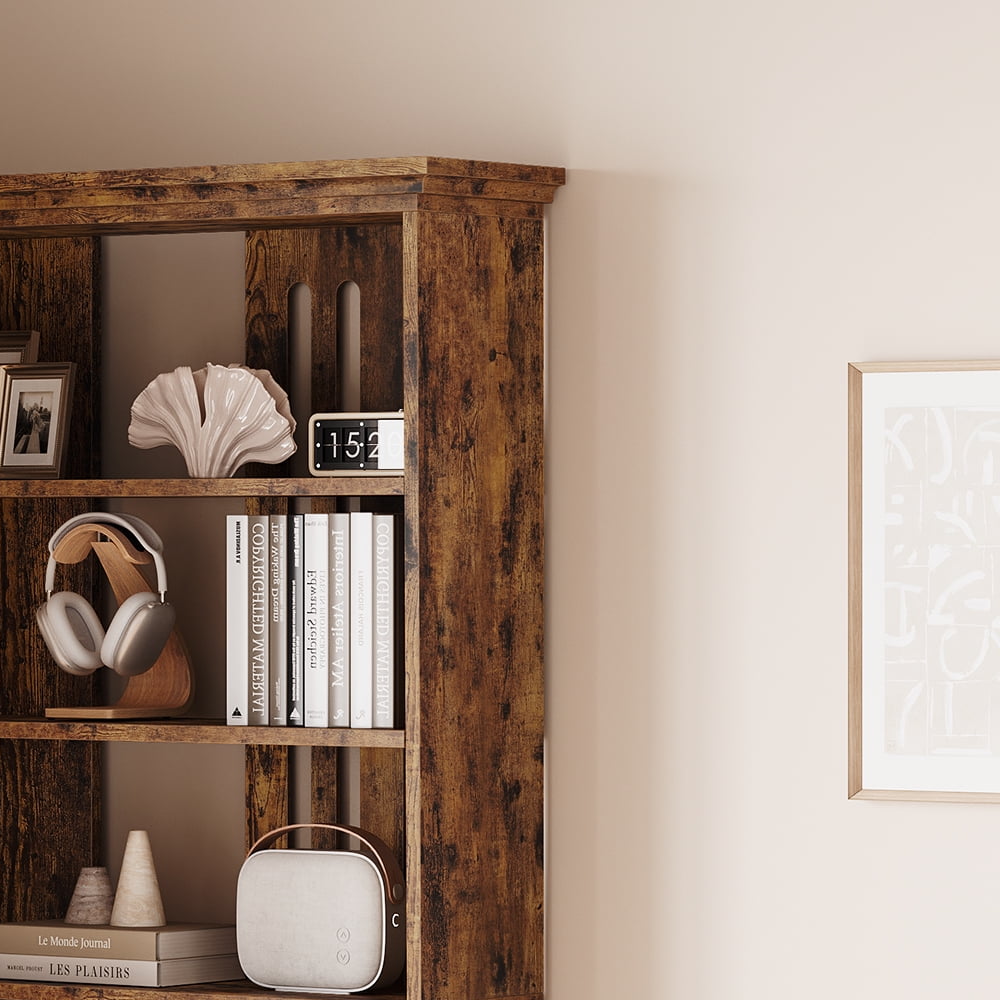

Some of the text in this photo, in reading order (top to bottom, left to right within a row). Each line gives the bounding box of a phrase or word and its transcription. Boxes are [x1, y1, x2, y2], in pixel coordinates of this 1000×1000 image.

[38, 936, 110, 949] Le Monde Journal
[49, 963, 70, 975] LES
[76, 965, 130, 978] PLAISIRS
